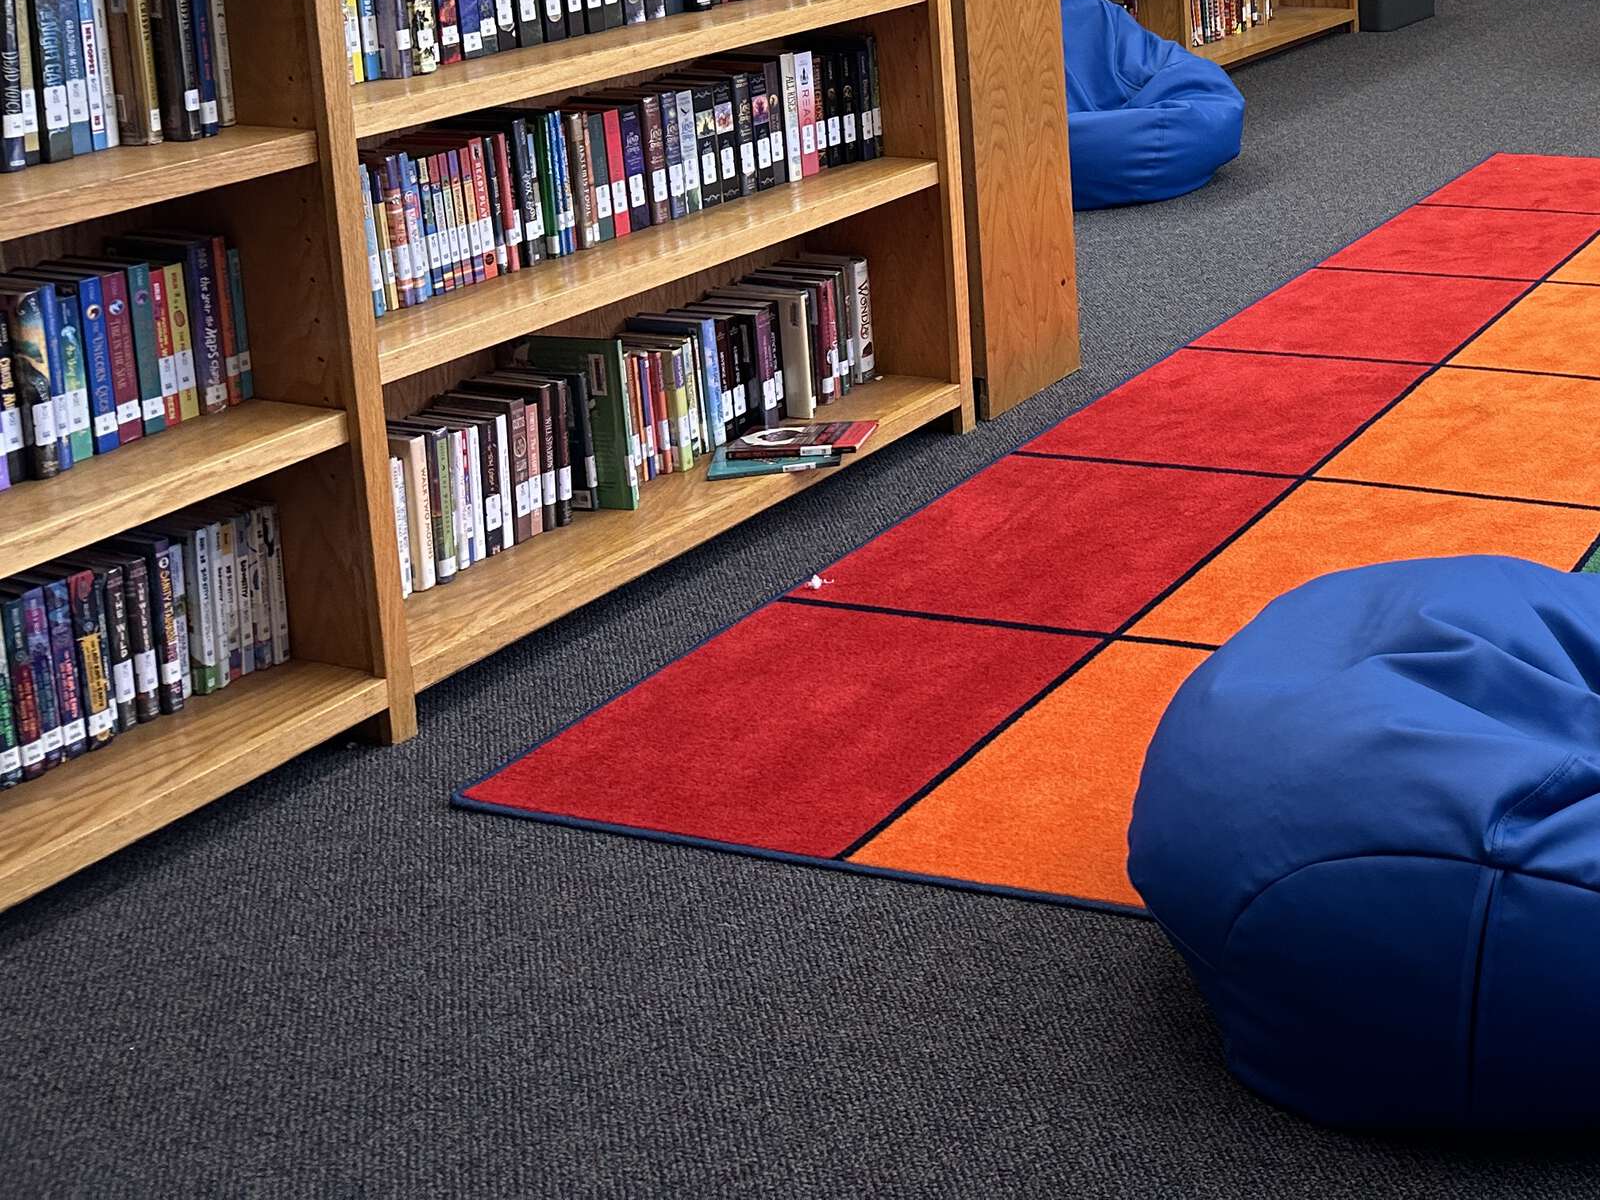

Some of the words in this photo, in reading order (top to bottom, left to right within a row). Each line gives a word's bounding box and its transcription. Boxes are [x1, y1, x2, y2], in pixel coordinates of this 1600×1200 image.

[138, 2, 151, 40] CRISPIN
[40, 19, 61, 60] NIGHT
[65, 20, 79, 56] GRASPING
[1, 51, 19, 81] DEAD
[3, 85, 21, 115] VOICE
[801, 89, 811, 125] REAC
[475, 162, 485, 192] READY
[579, 145, 590, 186] ARTEMIS
[583, 188, 592, 217] FOWL
[0, 357, 16, 390] CIRCUS
[92, 336, 107, 382] UNICORN
[95, 385, 110, 412] QUES
[425, 522, 434, 560] MOONS
[160, 571, 172, 600] SANITY
[117, 625, 129, 658] WILD
